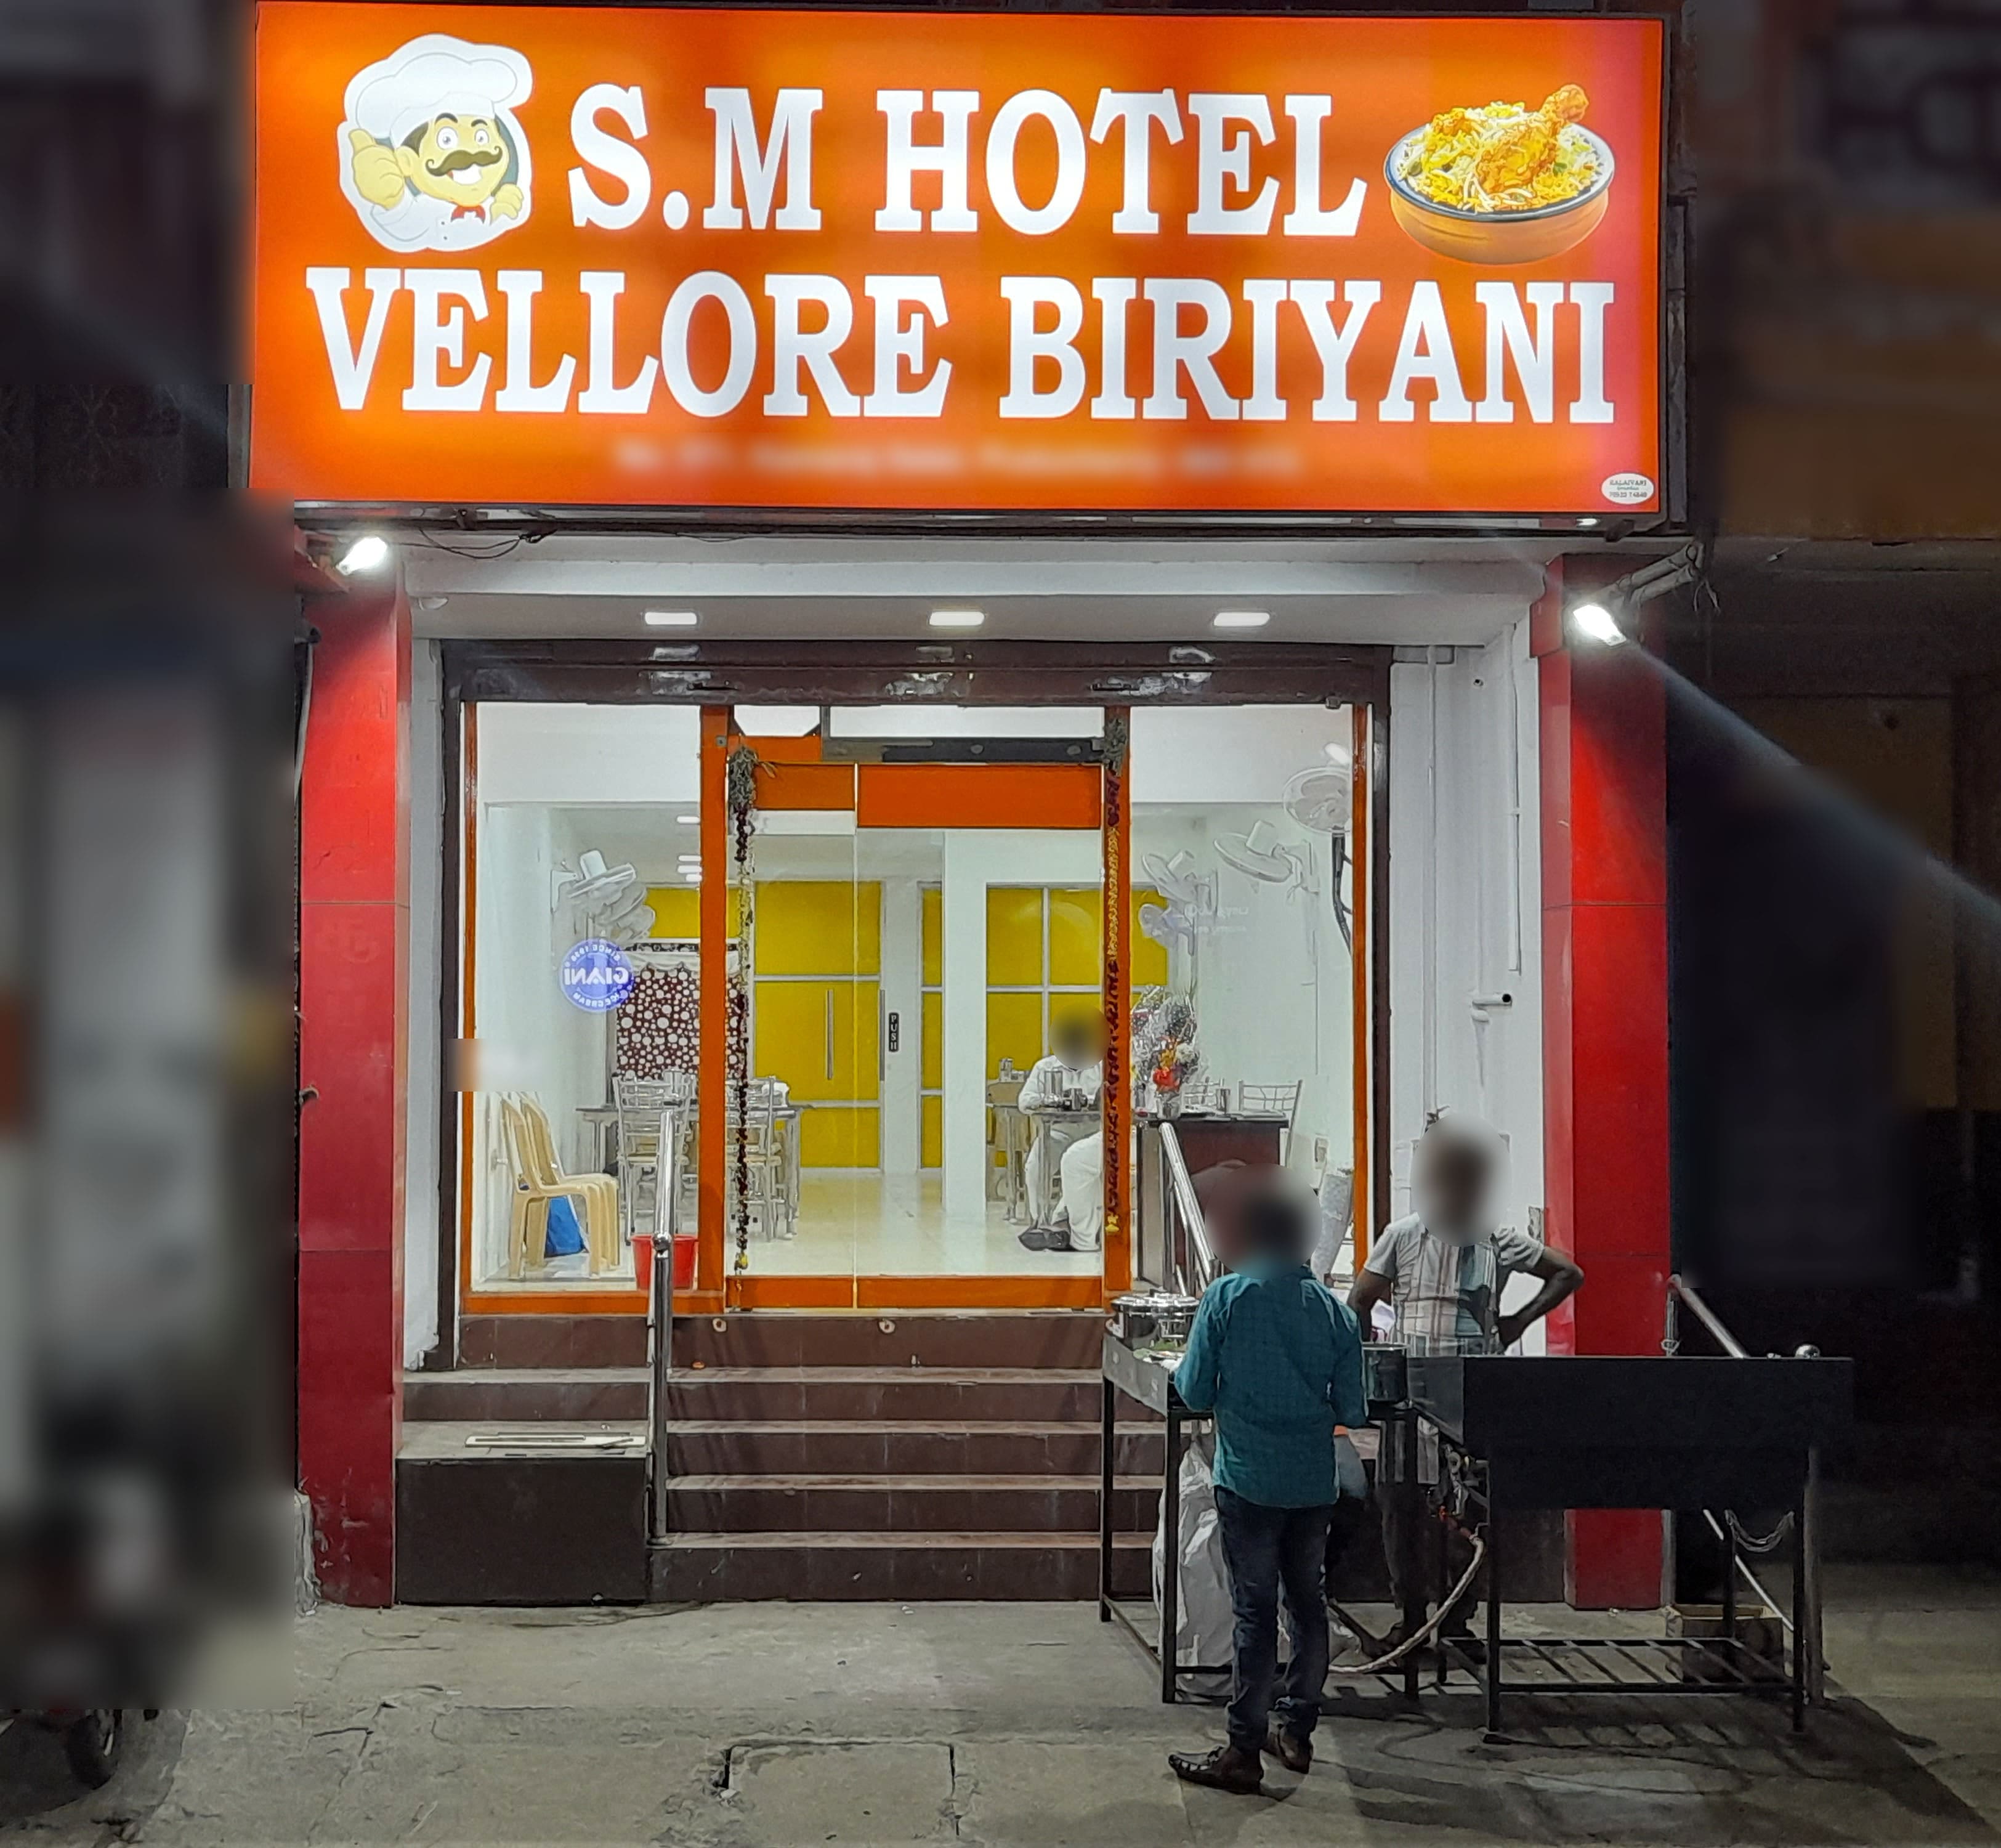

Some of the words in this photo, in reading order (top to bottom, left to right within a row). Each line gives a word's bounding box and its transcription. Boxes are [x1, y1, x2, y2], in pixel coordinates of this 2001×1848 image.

[567, 83, 823, 231] S.M
[874, 87, 1368, 237] HOTEL
[305, 266, 953, 418] VELLORE
[999, 275, 1615, 424] BIRIYANI
